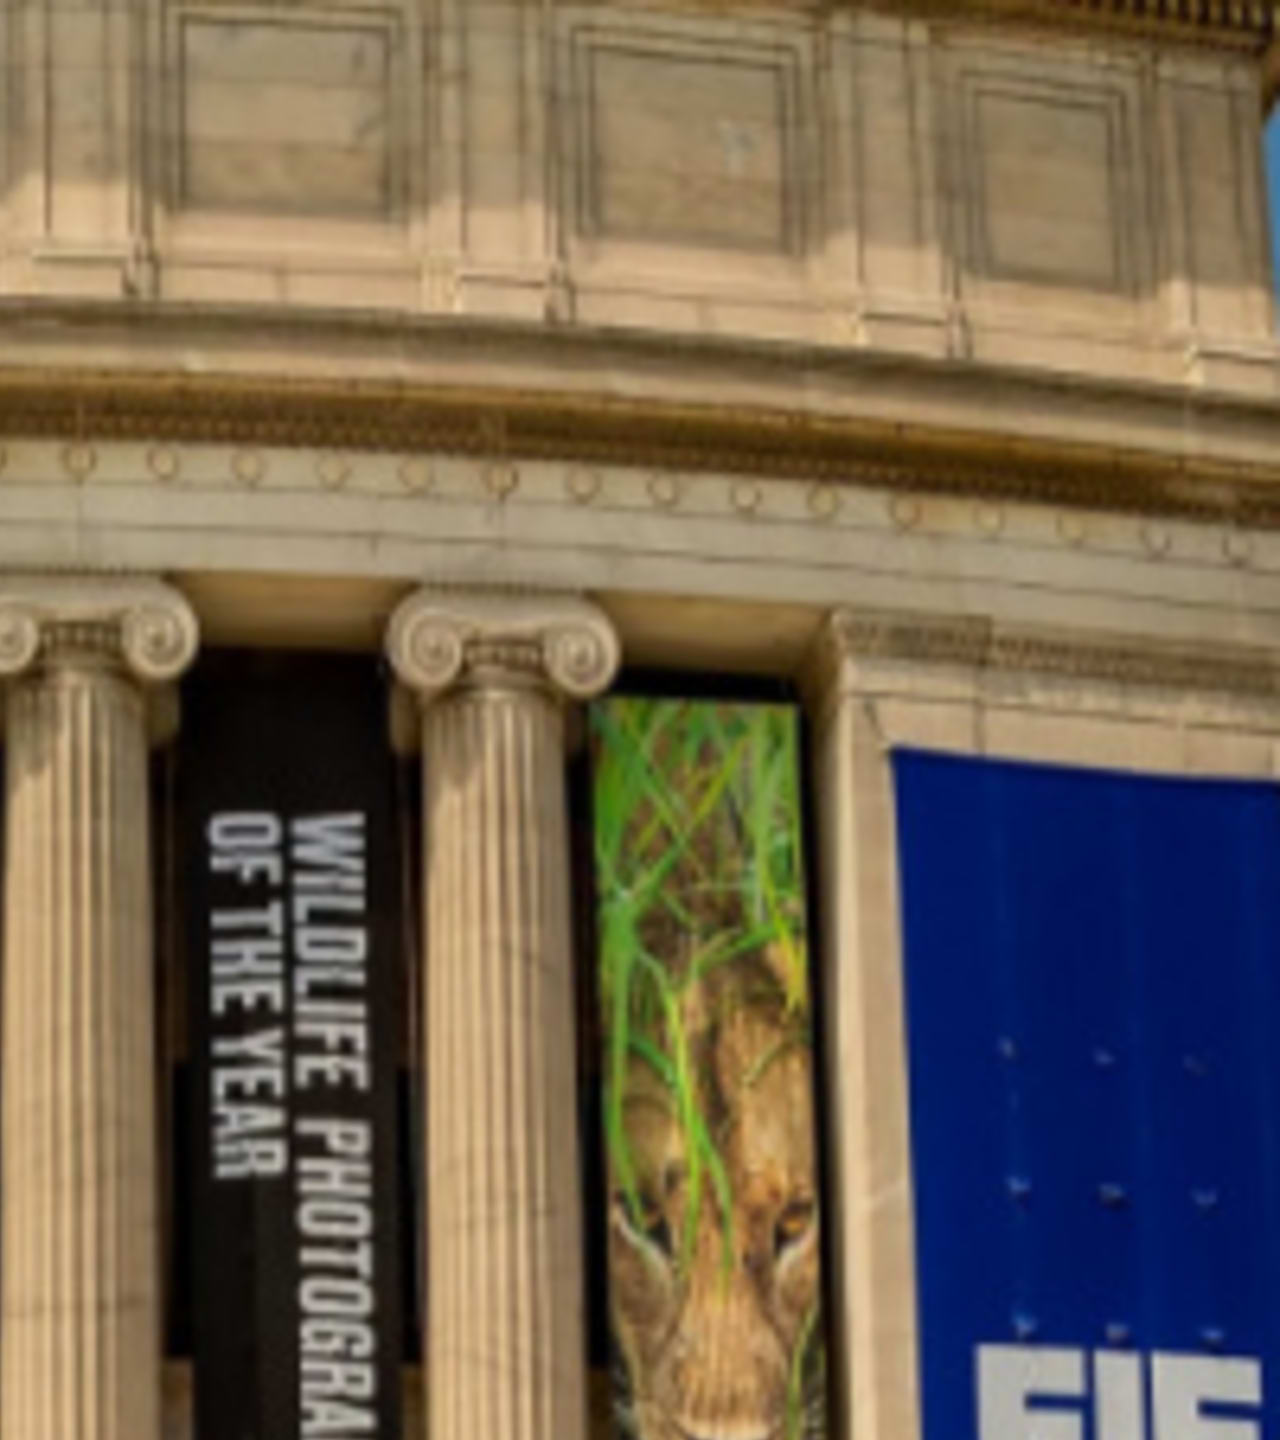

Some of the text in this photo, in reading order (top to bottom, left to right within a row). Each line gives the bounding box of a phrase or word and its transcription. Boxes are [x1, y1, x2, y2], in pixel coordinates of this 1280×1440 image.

[207, 811, 288, 1181] OF THE YEAR
[290, 811, 369, 1091] WILDLIFE
